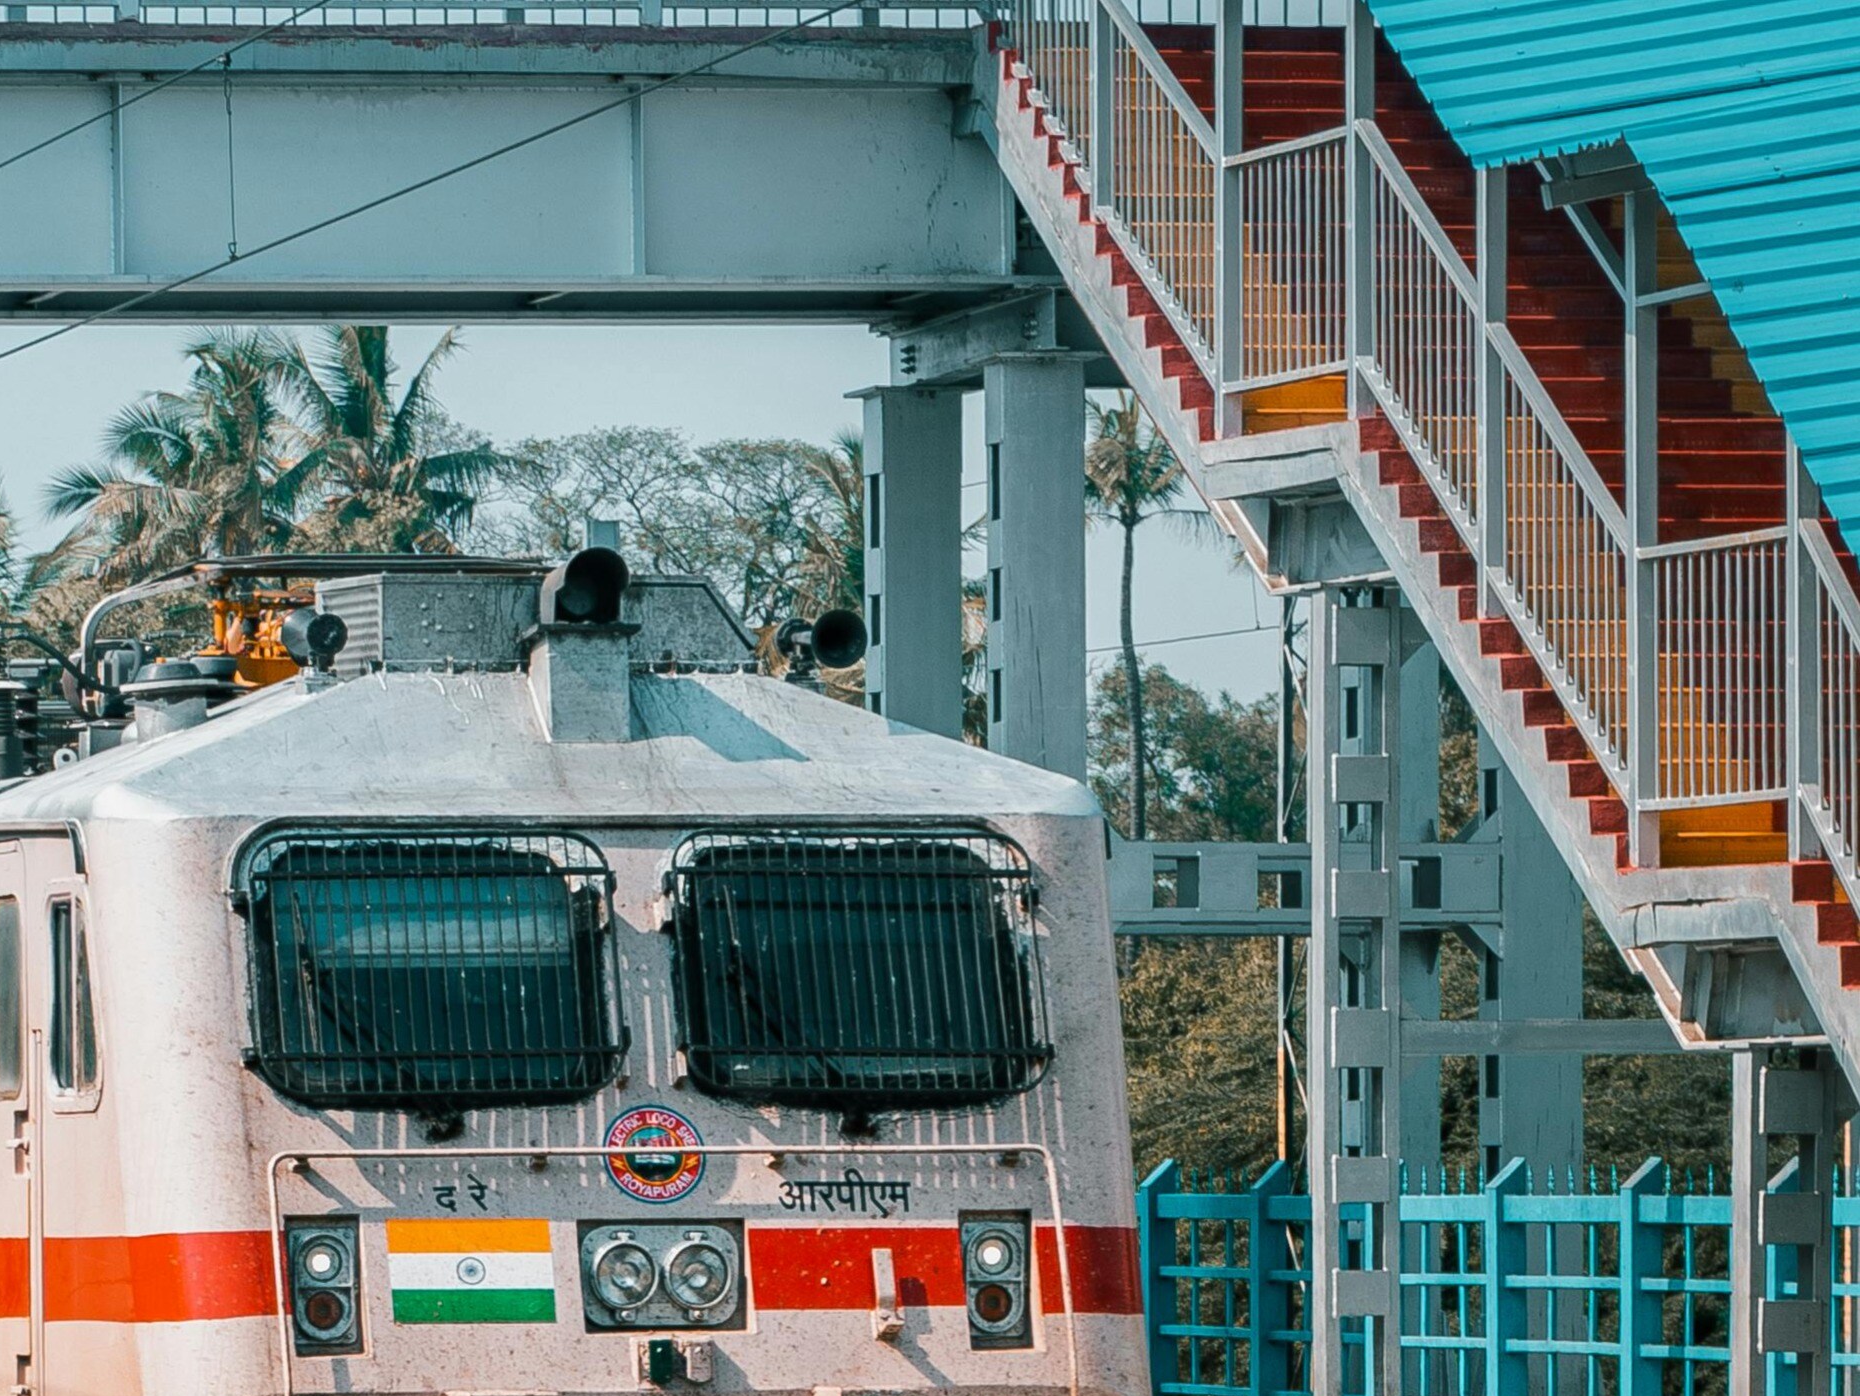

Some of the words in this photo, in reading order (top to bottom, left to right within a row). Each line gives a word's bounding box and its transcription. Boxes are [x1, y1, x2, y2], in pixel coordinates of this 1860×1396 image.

[610, 1114, 643, 1149] LECTRIC
[645, 1112, 677, 1129] LOCO
[676, 1125, 697, 1149] SHE
[432, 1185, 457, 1213] द
[467, 1173, 489, 1212] रे
[620, 1171, 693, 1198] ROYAPURAM
[778, 1167, 911, 1218] आरपीएम
